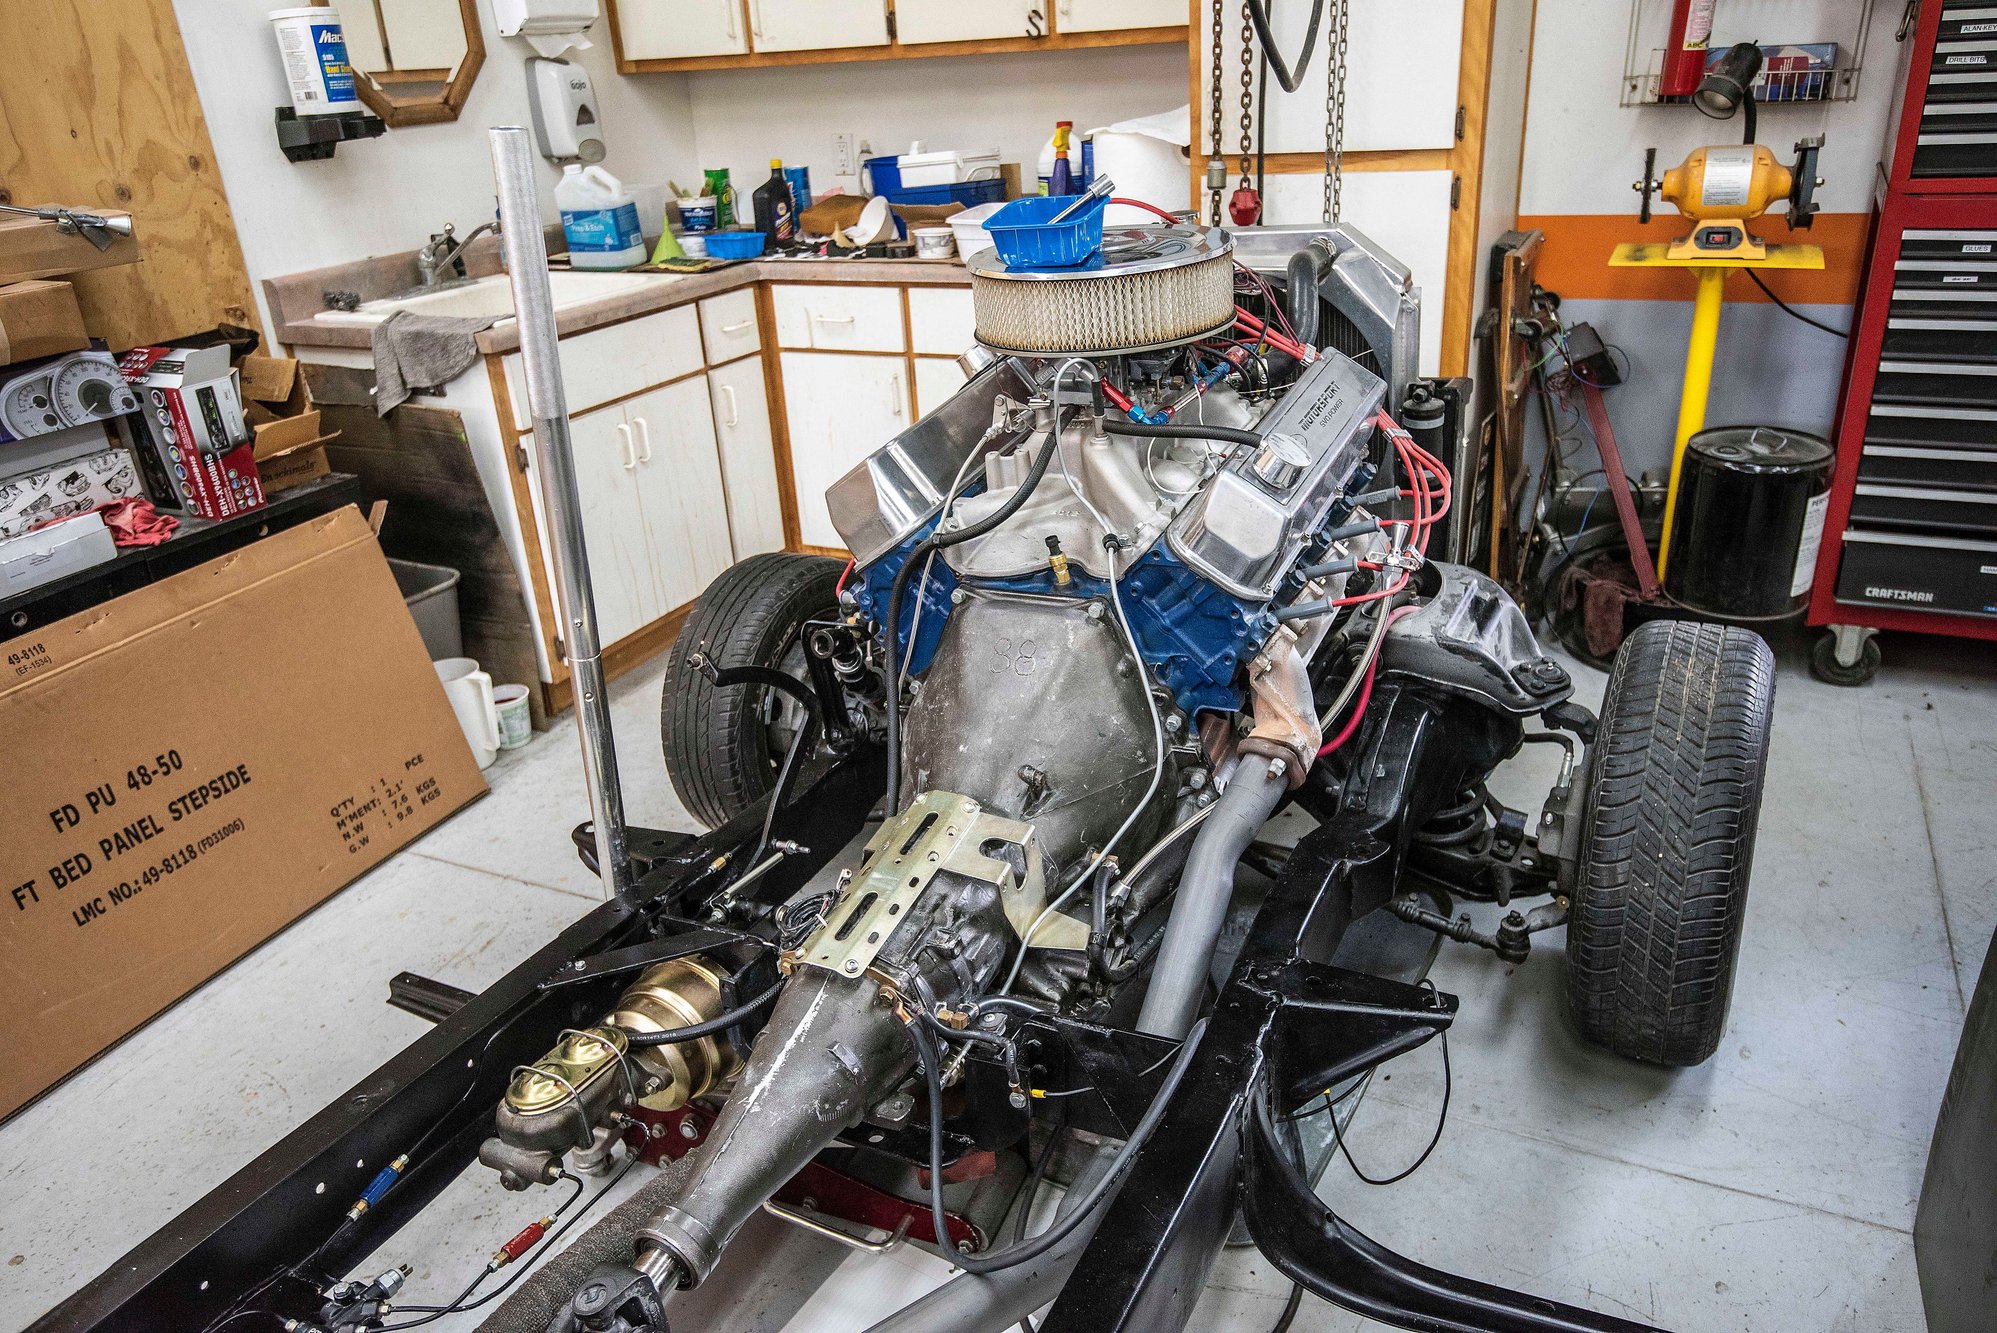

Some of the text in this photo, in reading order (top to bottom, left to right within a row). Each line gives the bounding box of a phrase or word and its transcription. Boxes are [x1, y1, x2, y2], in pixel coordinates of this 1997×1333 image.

[1298, 380, 1341, 431] MOTORSPORT
[204, 453, 230, 517] DEH-X9600BHS
[1865, 586, 1934, 602] CRAFTSMAN
[8, 643, 46, 666] 49-8118
[49, 749, 183, 834] FD PU 48-50
[330, 796, 355, 817] Q'TY
[404, 754, 424, 771] PCE
[342, 821, 364, 842] N.W
[391, 793, 408, 810] 7.6
[415, 777, 436, 795] KGS
[11, 763, 252, 911] FT BED PANEL STEPSIDE
[349, 835, 369, 854] G.W
[396, 805, 413, 821] 9.8
[420, 788, 441, 806] KGS
[72, 897, 107, 927] LMC
[199, 817, 245, 855] (FD31006)
